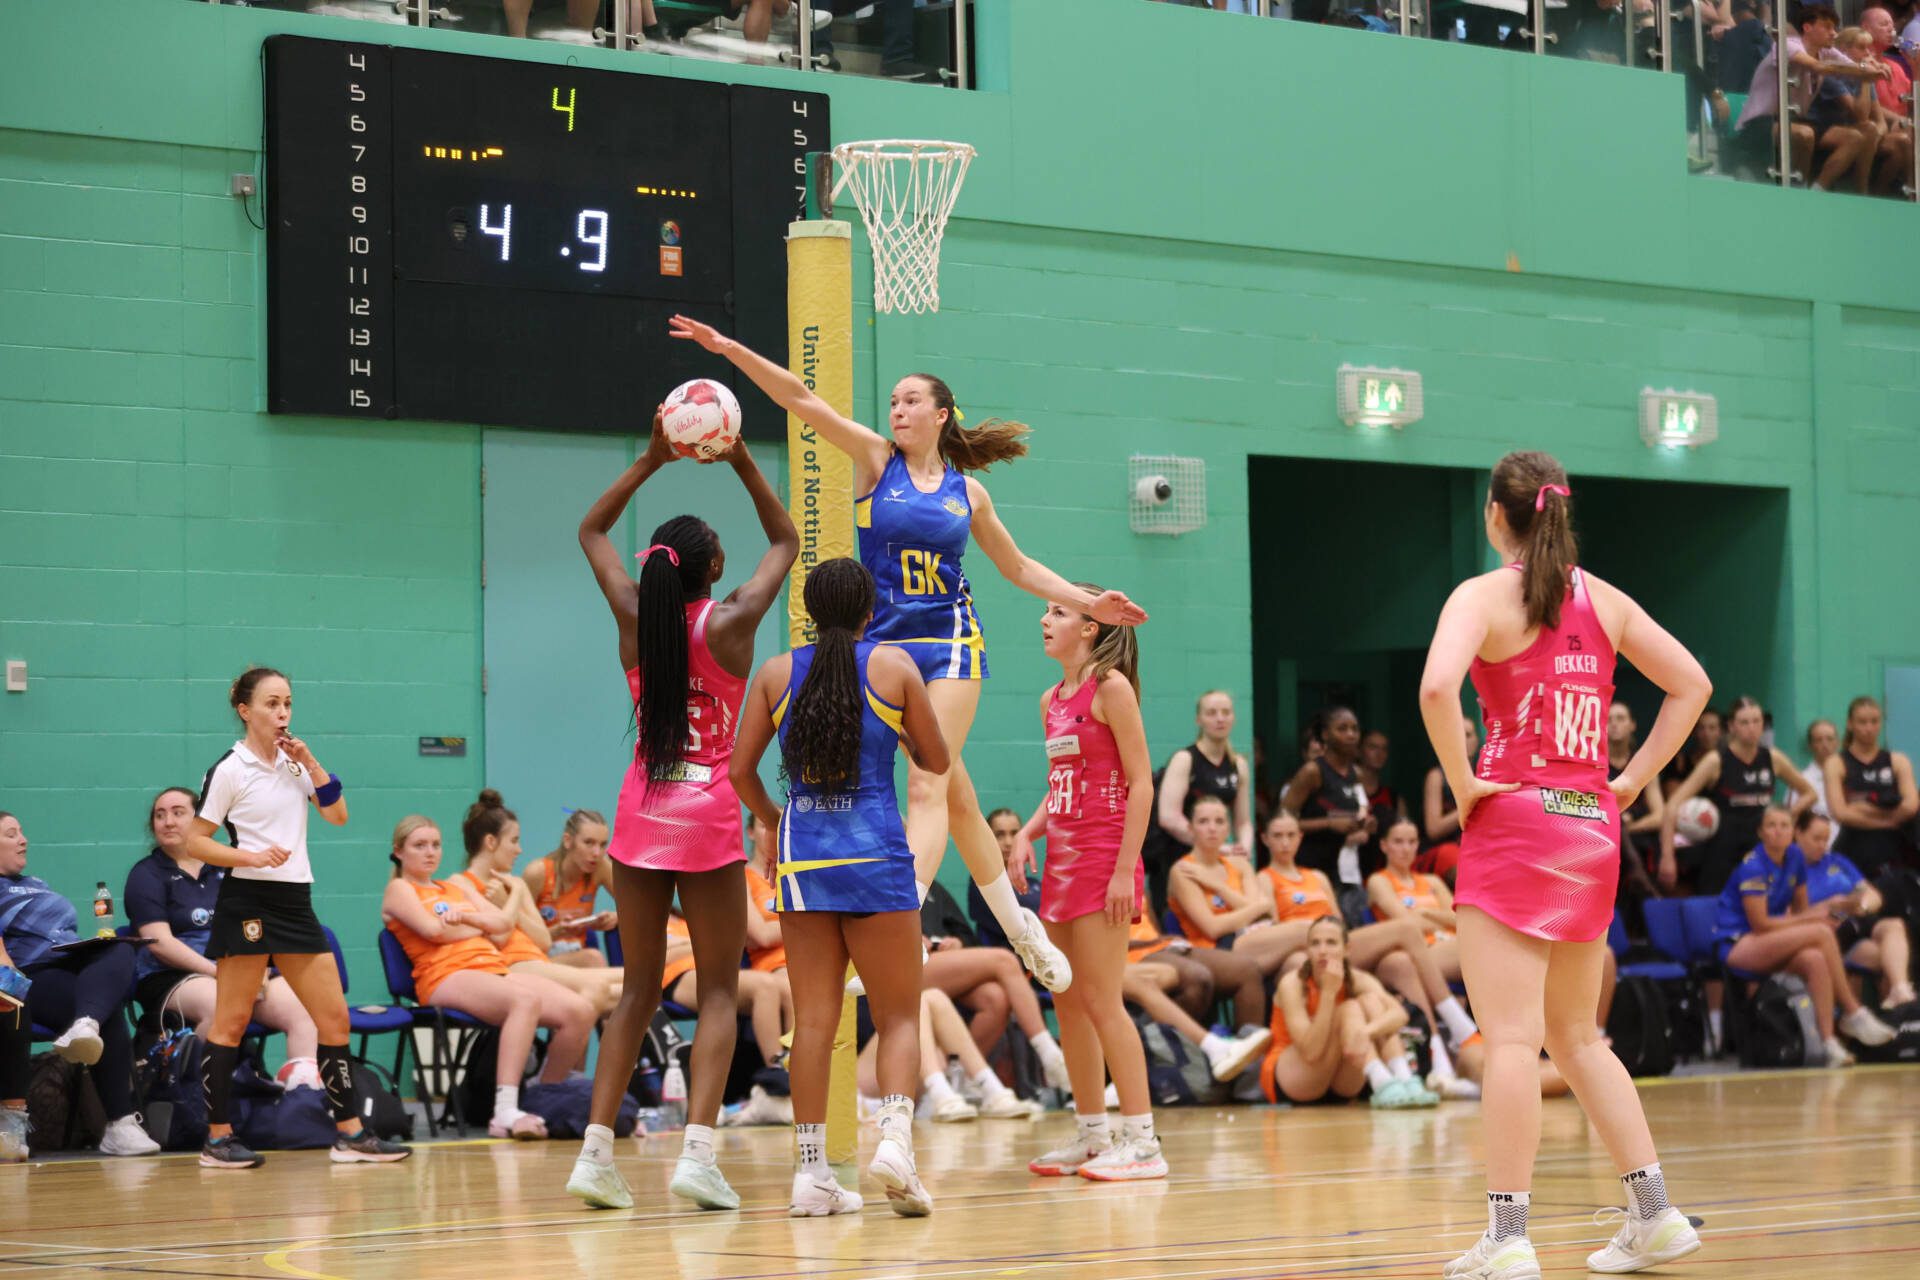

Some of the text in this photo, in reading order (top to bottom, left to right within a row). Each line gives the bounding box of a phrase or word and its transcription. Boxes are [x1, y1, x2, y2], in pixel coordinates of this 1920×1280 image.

[350, 54, 366, 72] 4
[350, 84, 366, 102] 5
[552, 87, 576, 132] 4
[793, 100, 808, 118] 4
[350, 114, 366, 132] 6
[793, 129, 808, 146] 5
[351, 145, 366, 162] 7
[794, 158, 807, 175] 6
[351, 175, 367, 193] 8
[795, 186, 807, 203] 7
[351, 206, 367, 224] 9
[480, 204, 512, 261] 4
[349, 236, 369, 254] 10
[349, 267, 367, 285] 11
[350, 297, 370, 316] 12
[350, 328, 370, 346] 13
[350, 359, 371, 377] 14
[801, 326, 819, 444] Univey
[350, 389, 371, 408] 15
[804, 450, 821, 473] of
[801, 478, 822, 575] Notting
[900, 549, 948, 596] GK
[1567, 635, 1582, 651] 25
[1554, 654, 1598, 675] DEKKER
[1554, 690, 1602, 761] WA
[1620, 1170, 1648, 1185] YPR
[1487, 1193, 1514, 1203] YPR
